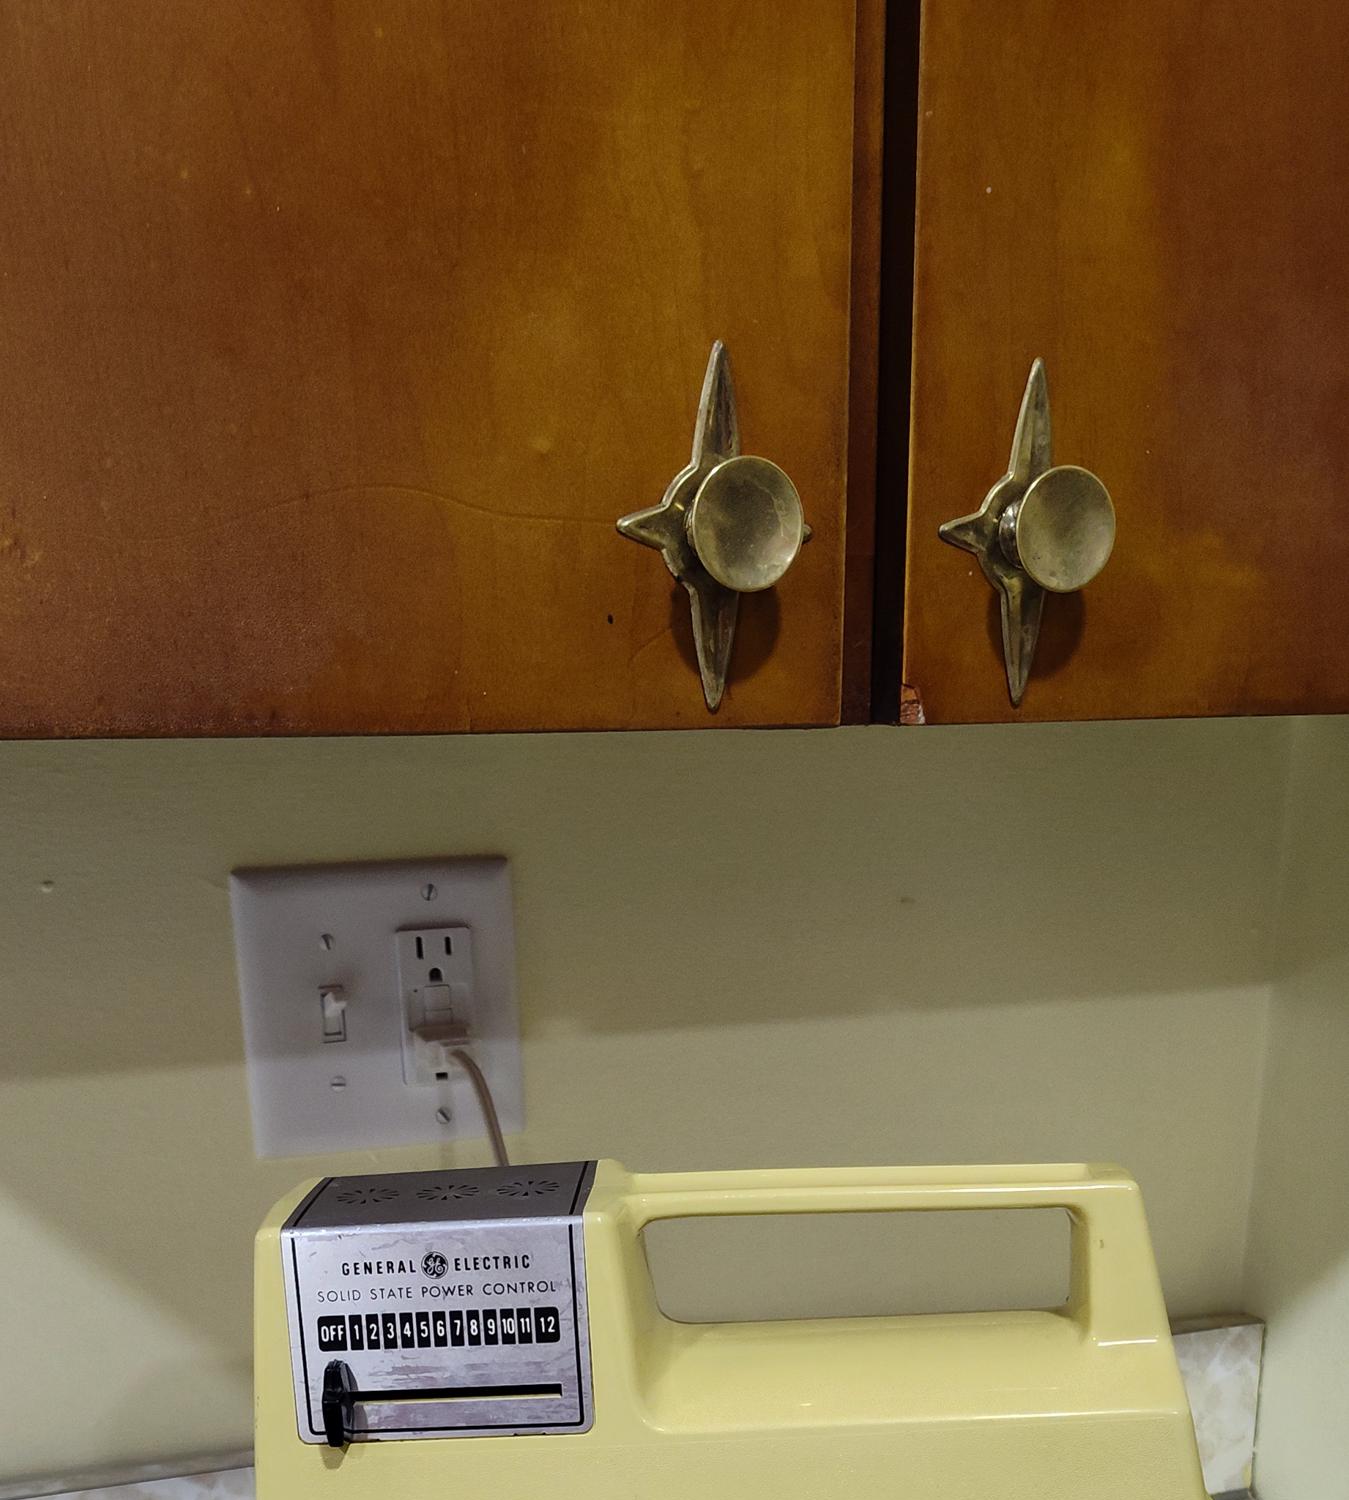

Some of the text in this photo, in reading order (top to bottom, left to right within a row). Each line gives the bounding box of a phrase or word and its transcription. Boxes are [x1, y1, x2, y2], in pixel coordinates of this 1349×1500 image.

[342, 1260, 416, 1276] GENERAL
[454, 1254, 531, 1272] ELECTRIC
[317, 1280, 556, 1302] SOLID STATE POWER CONTROL
[320, 1316, 555, 1342] OFF 1 2 3 4 5 6 7 8 9 10 11 12
